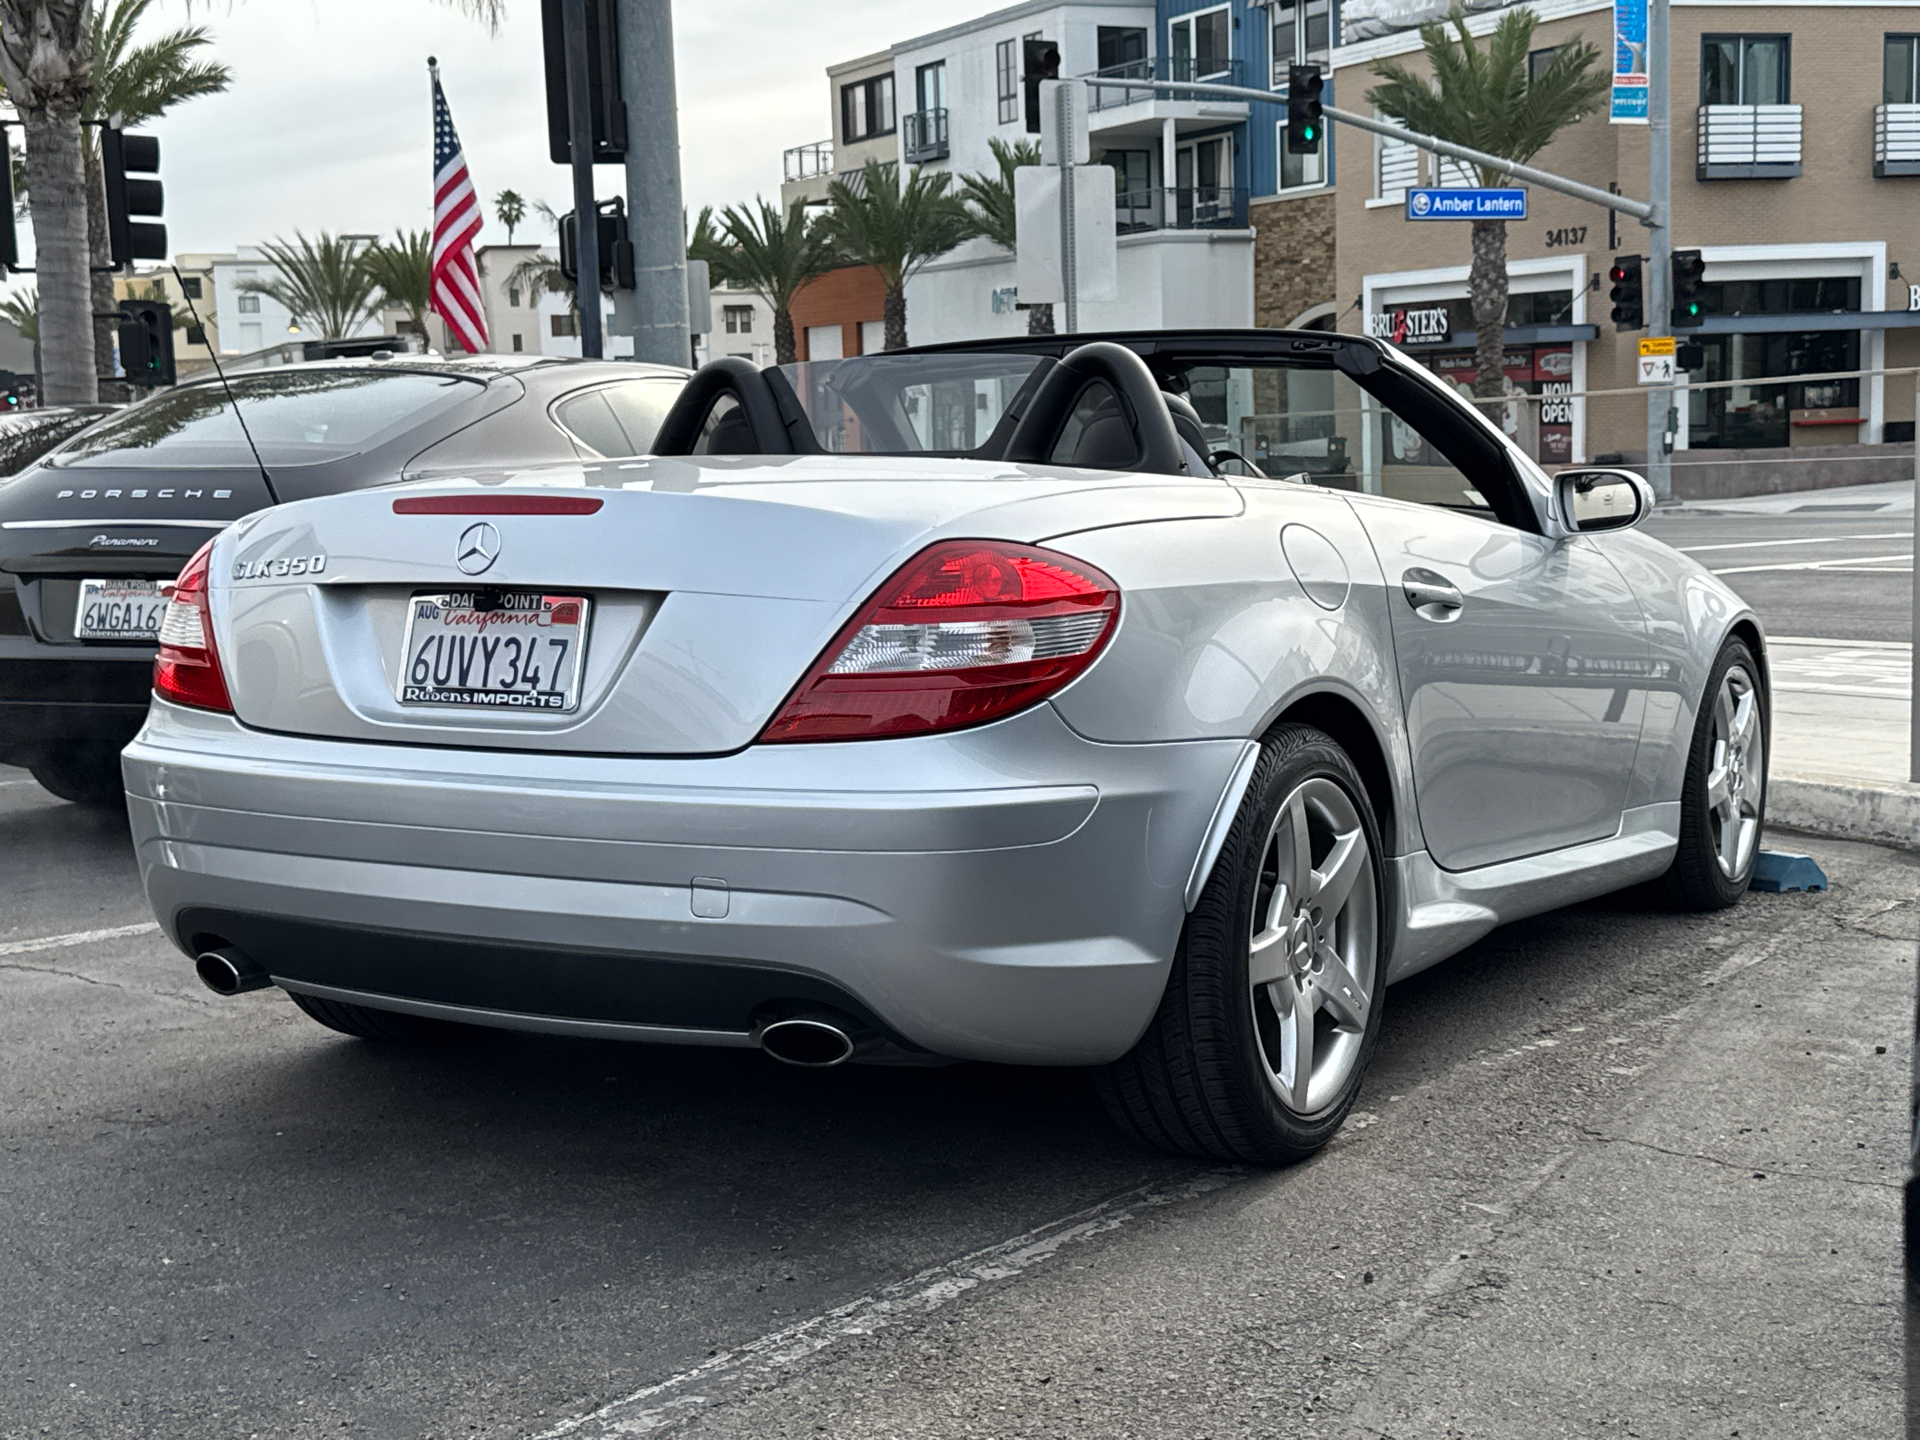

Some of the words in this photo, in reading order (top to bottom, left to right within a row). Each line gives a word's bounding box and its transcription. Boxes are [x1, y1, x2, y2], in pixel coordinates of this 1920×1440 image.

[1433, 197, 1474, 212] Amber
[1477, 196, 1522, 212] Lantern
[1545, 227, 1587, 247] 34137
[1542, 383, 1573, 404] NOW
[1542, 405, 1573, 423] OPEN
[57, 489, 232, 499] PORSCHE
[89, 535, 159, 546] Panamera
[232, 560, 273, 580] SLK
[275, 555, 327, 576] 350
[417, 604, 440, 620] AUG
[444, 609, 551, 634] California
[411, 635, 569, 690] 6UVY347
[405, 687, 471, 702] Rubens
[473, 694, 563, 708] IMPORTS
